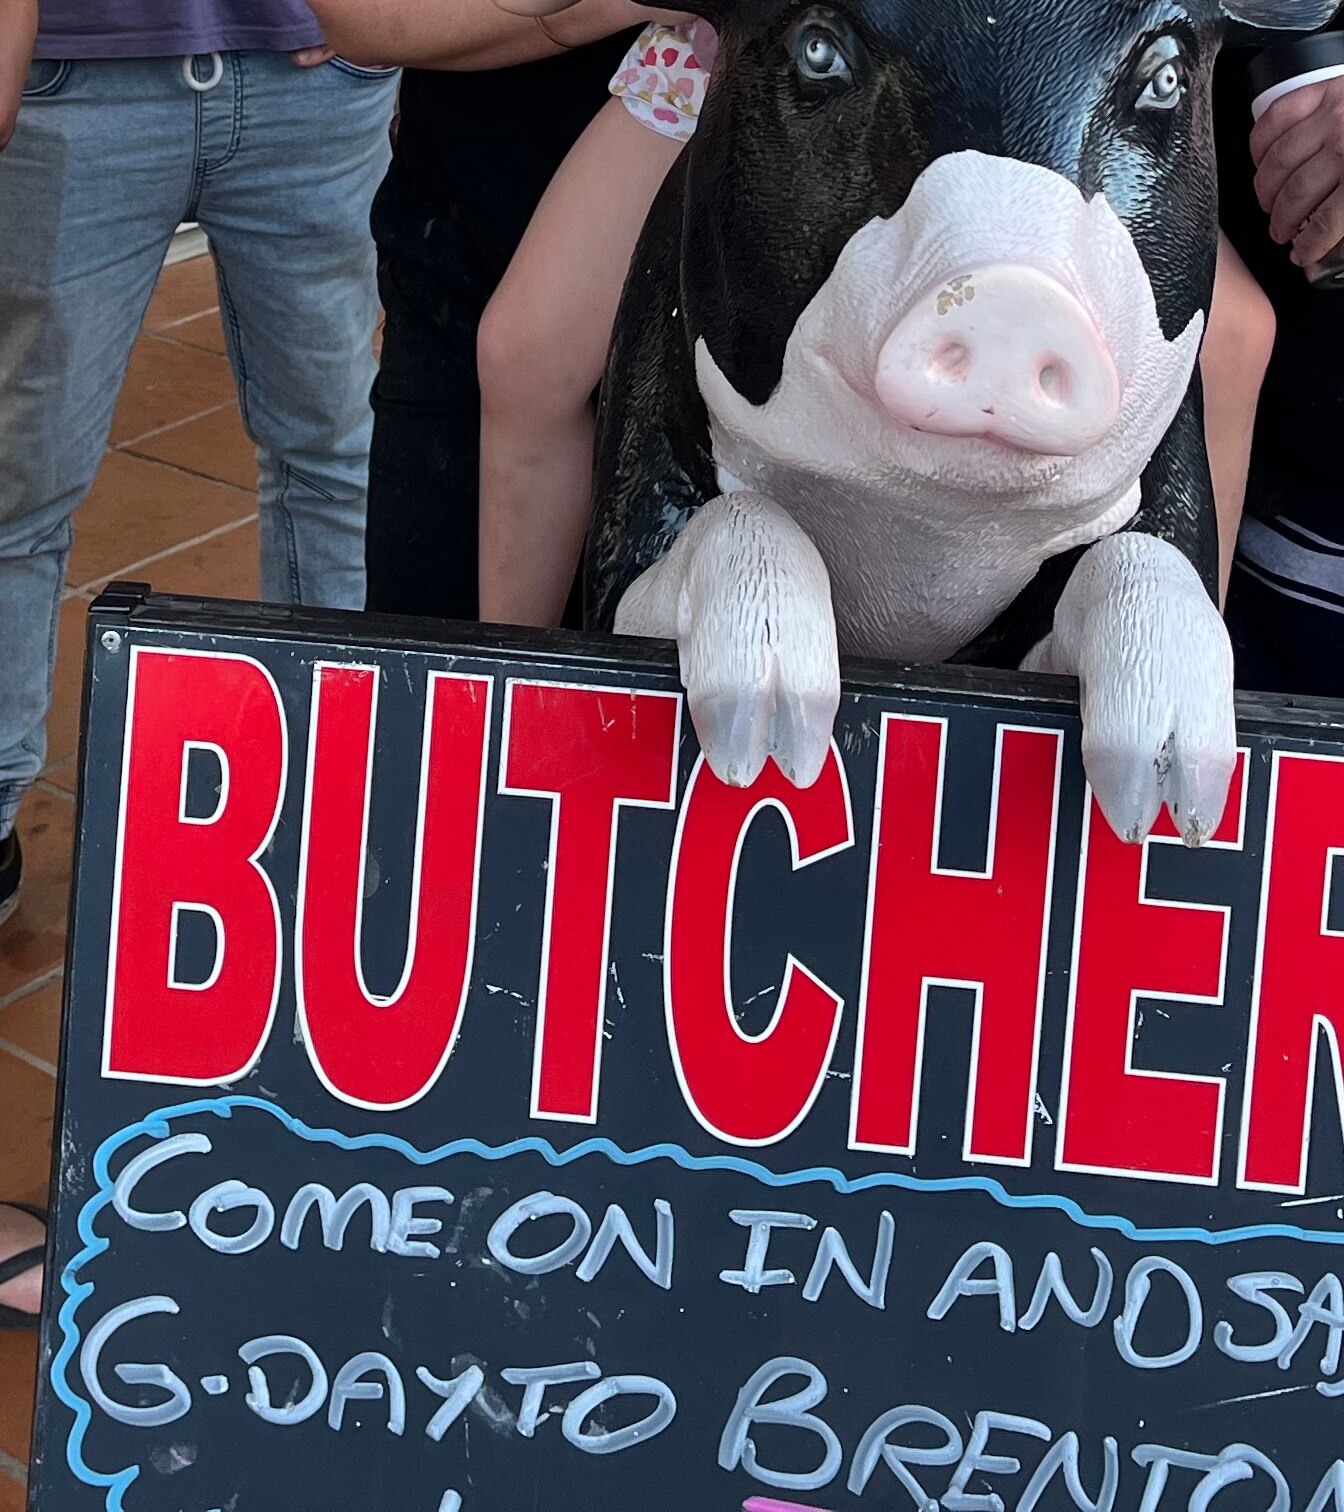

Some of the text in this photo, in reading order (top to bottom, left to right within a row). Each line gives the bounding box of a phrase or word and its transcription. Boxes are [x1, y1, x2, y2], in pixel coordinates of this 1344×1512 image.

[112, 1133, 454, 1258] COME
[487, 1192, 675, 1289] ON
[719, 1210, 896, 1309] IN
[926, 1241, 1203, 1368] AND
[500, 1361, 677, 1455] TO
